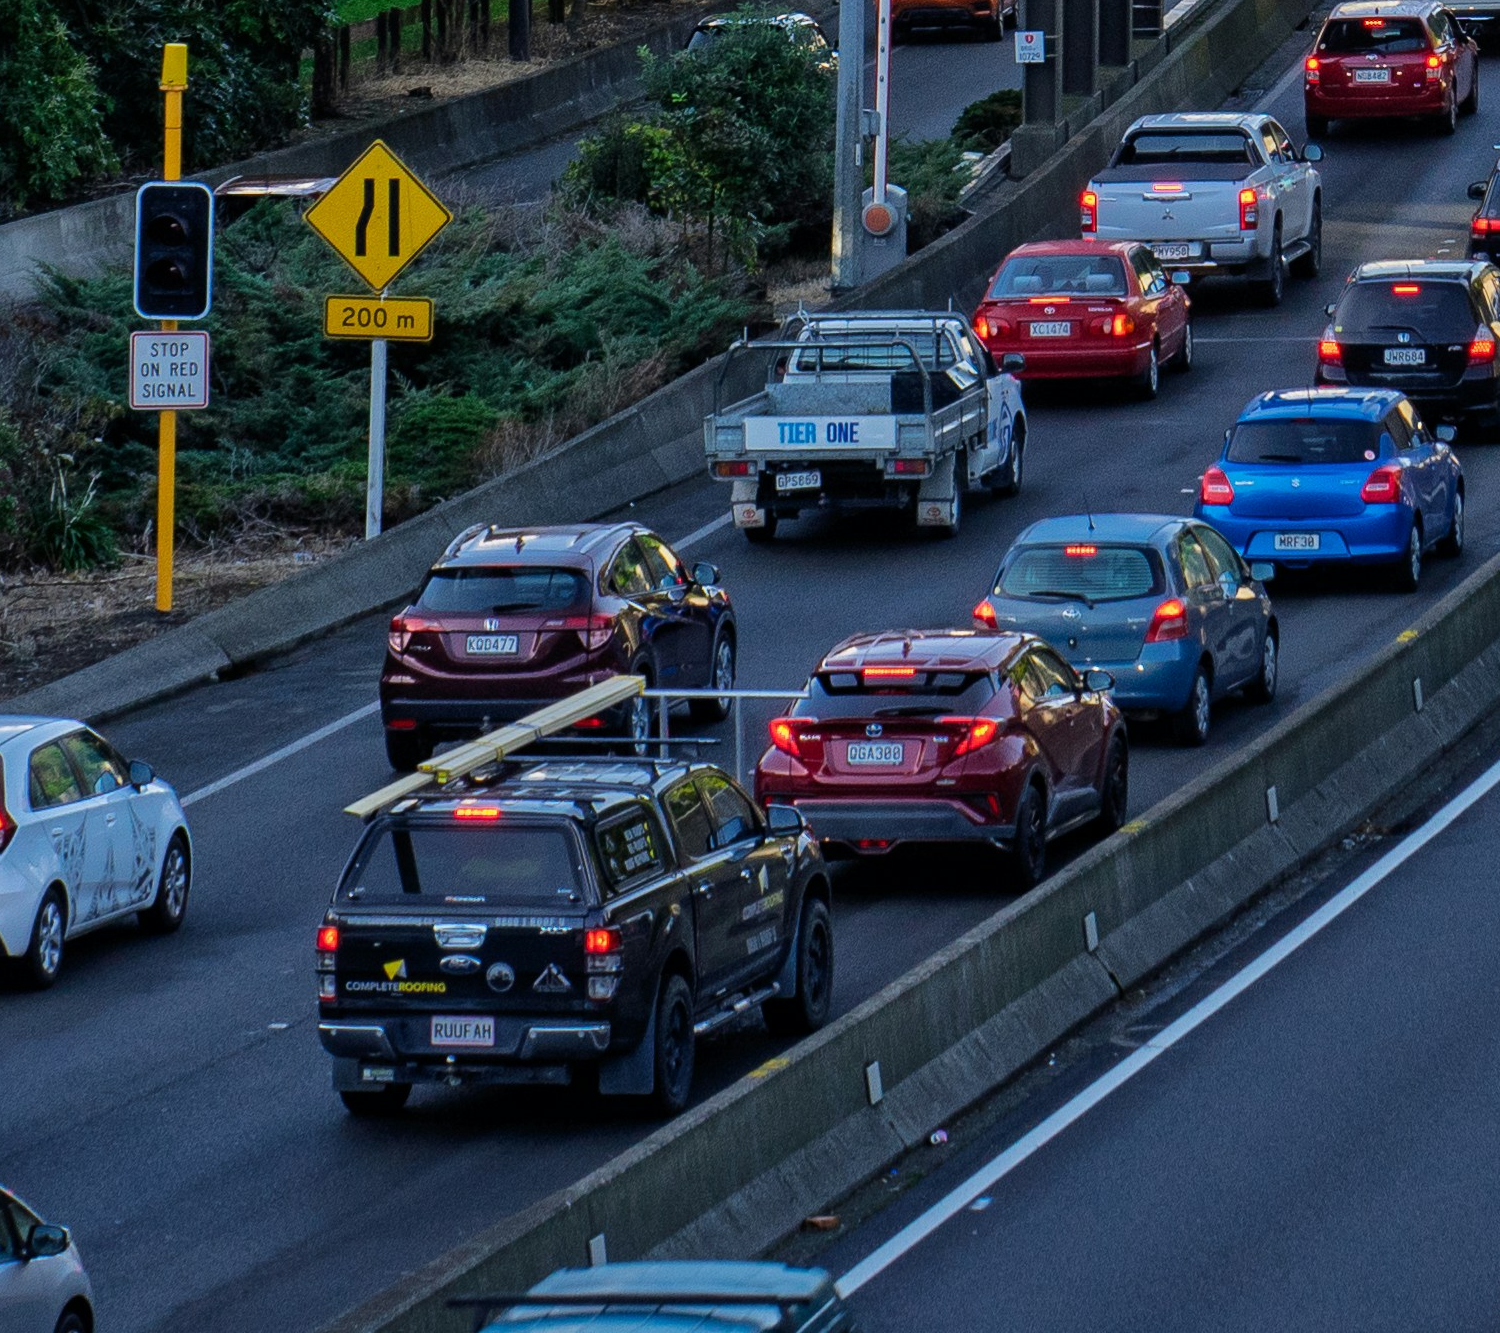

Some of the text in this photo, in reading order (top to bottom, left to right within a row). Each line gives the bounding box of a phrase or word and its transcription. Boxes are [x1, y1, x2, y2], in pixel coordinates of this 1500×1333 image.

[342, 307, 415, 329] 200 m
[150, 342, 190, 358] STOP
[140, 362, 198, 377] ON RED
[142, 382, 197, 399] SIGNAL
[777, 421, 860, 444] TIER ONE
